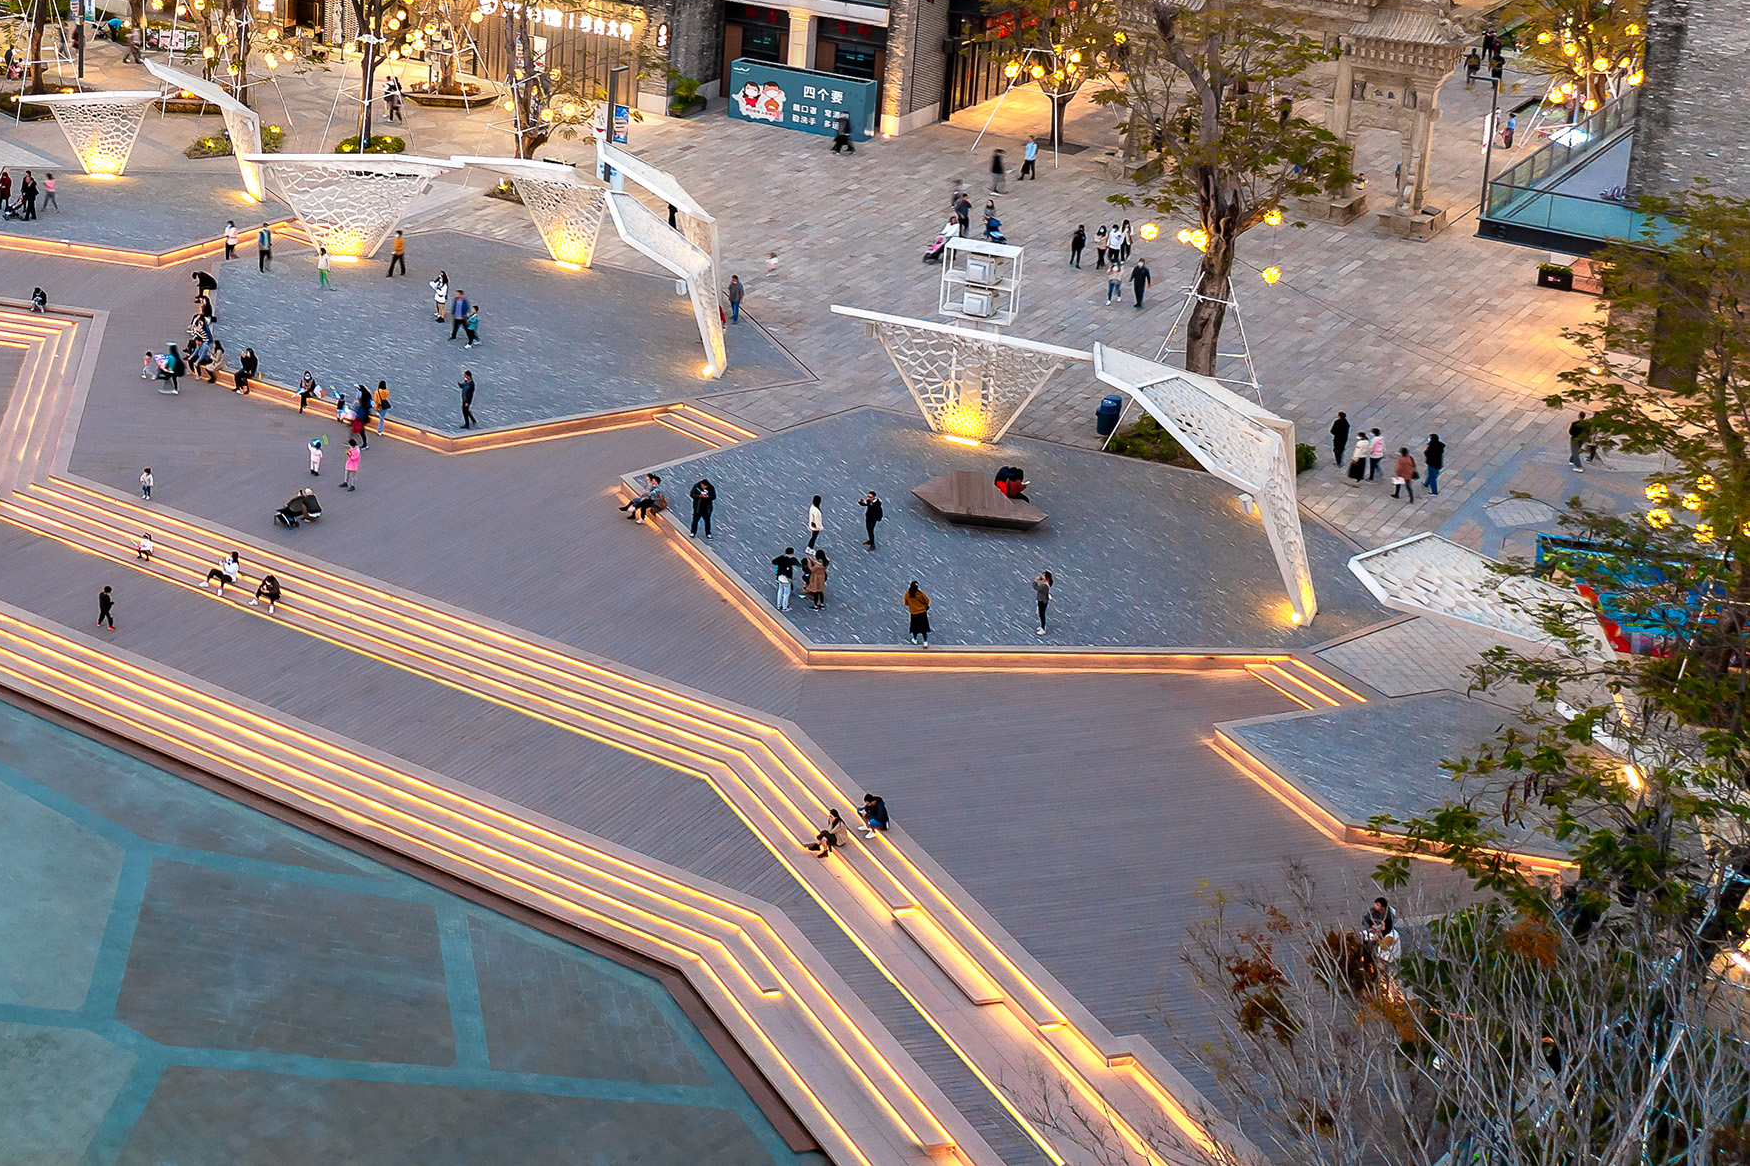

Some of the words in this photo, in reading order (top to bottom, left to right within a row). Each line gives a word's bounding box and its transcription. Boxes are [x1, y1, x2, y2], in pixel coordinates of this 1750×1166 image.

[803, 85, 844, 105] 四个要
[824, 119, 840, 130] 多运
